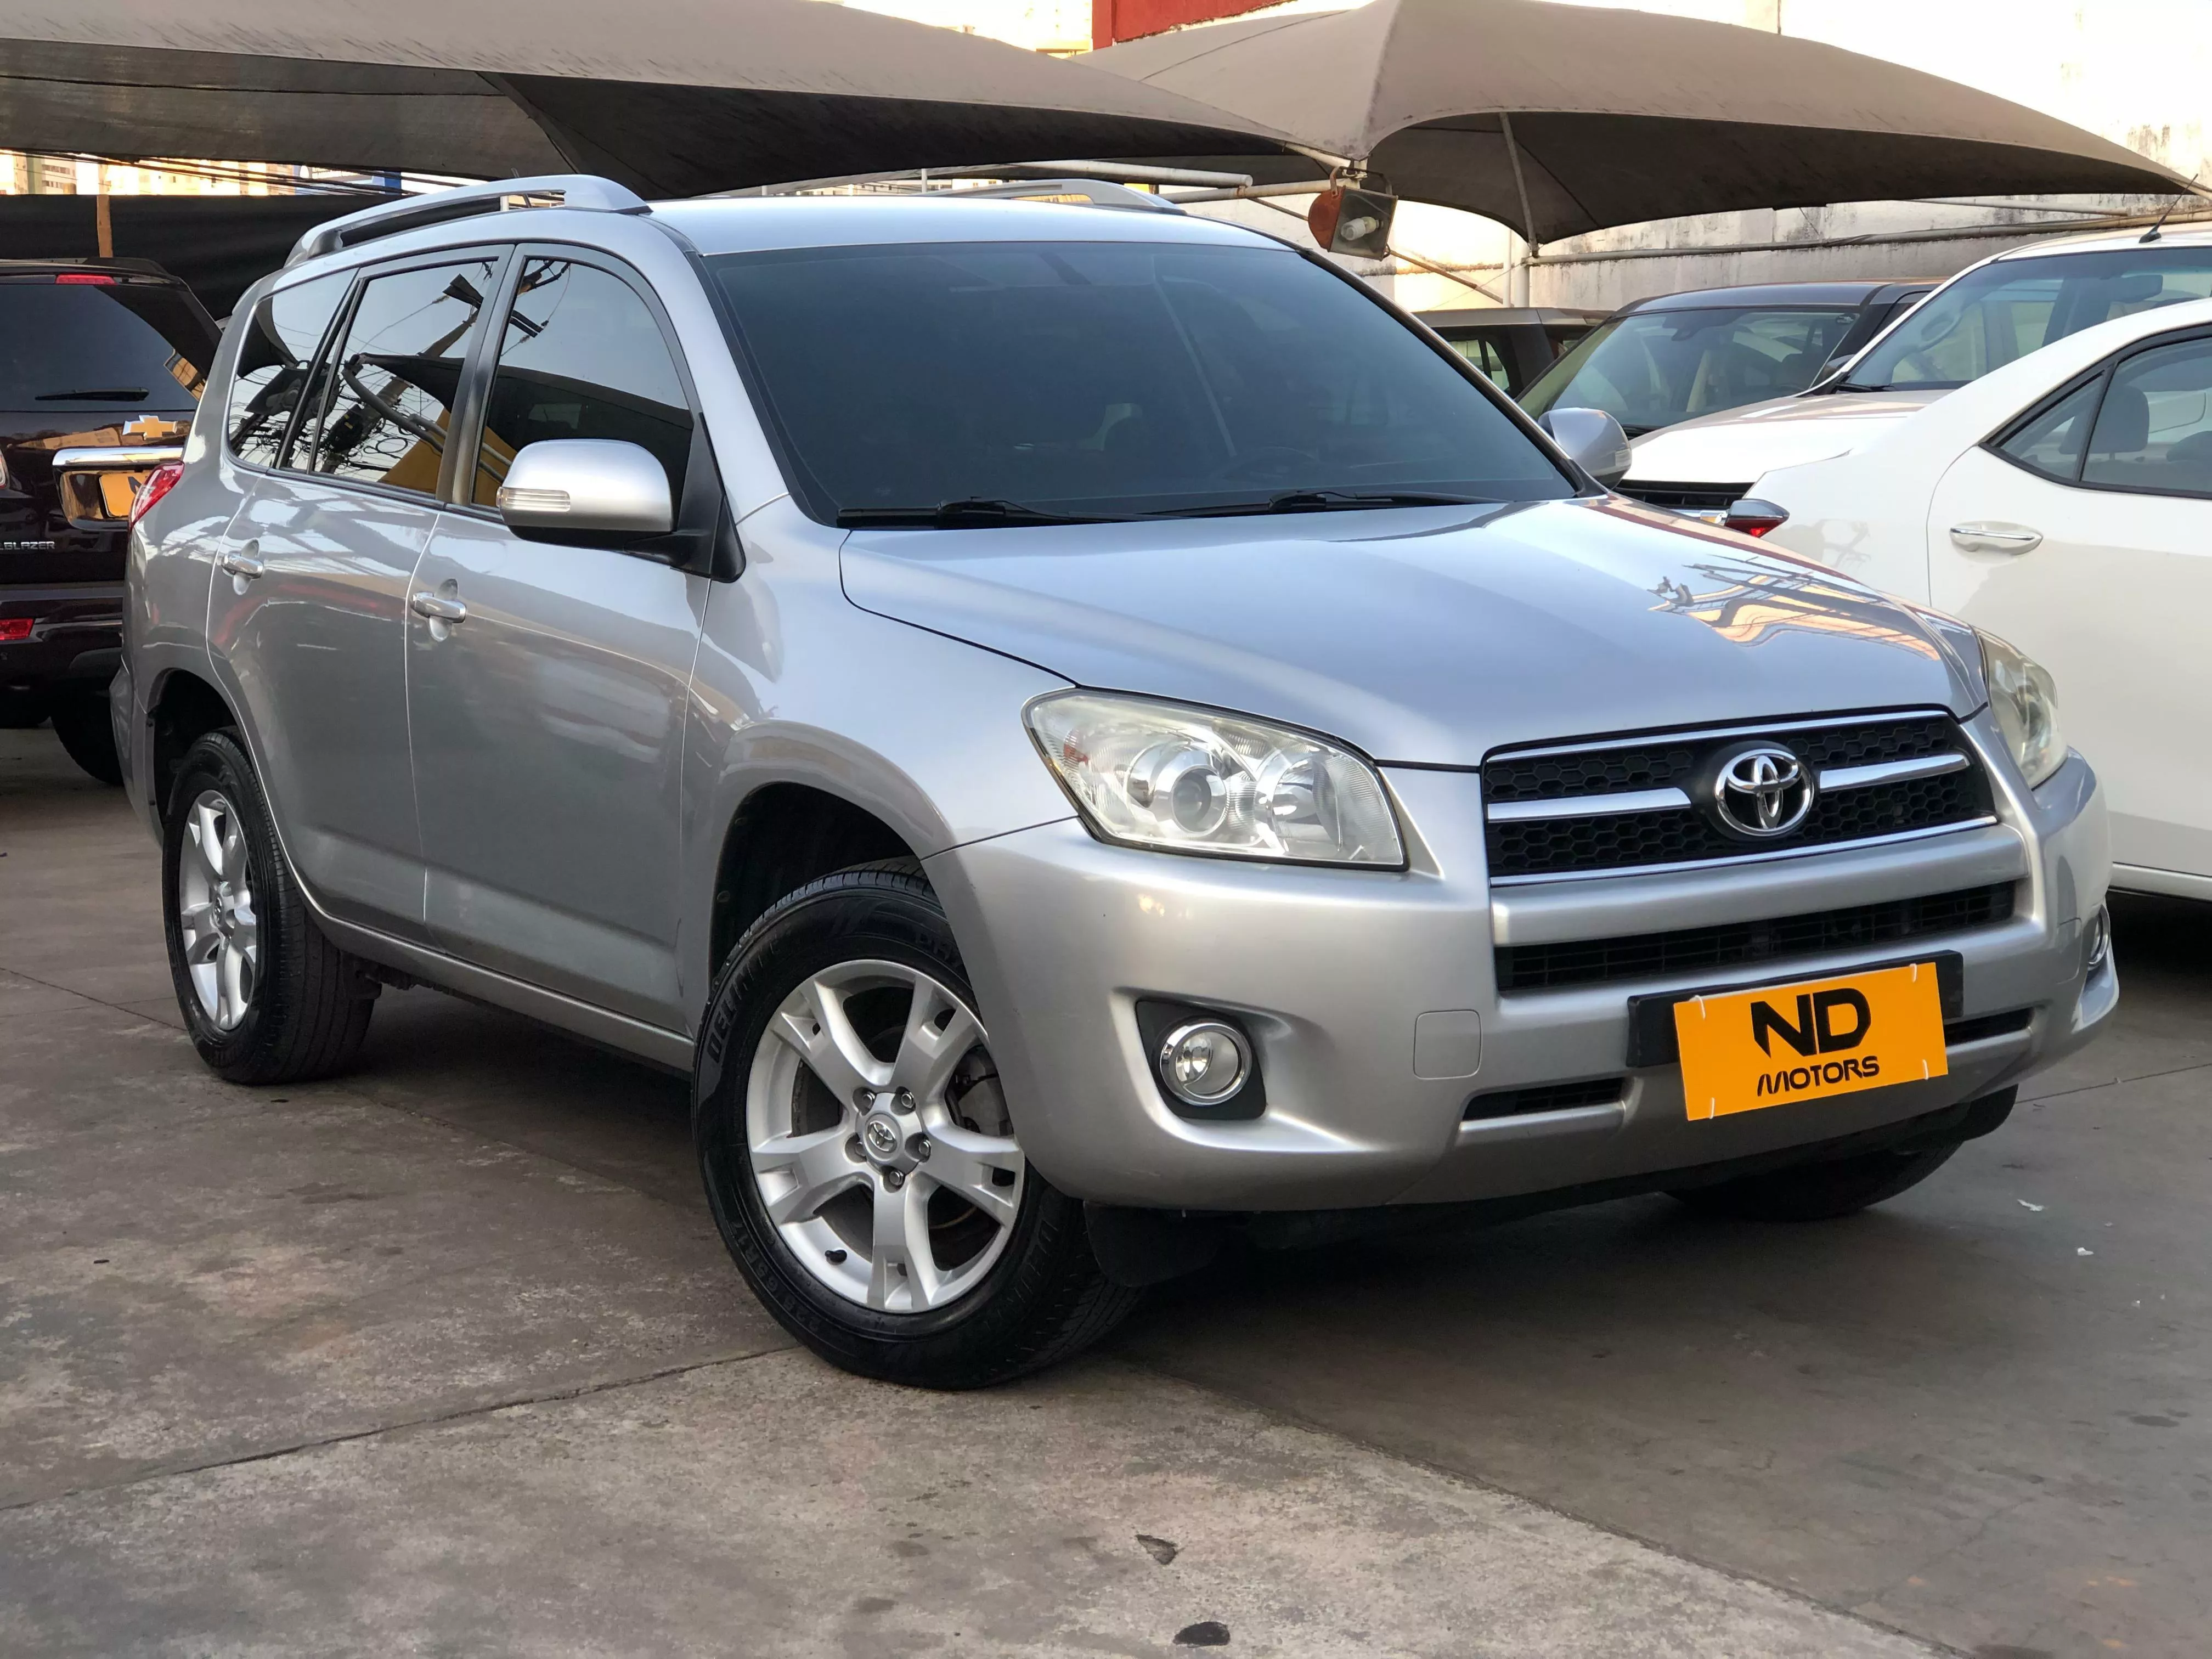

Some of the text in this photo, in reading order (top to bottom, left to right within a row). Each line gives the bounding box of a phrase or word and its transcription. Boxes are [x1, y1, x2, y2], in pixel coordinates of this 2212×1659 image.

[0, 541, 55, 550] BLAZER
[1751, 988, 1871, 1058] ND
[1757, 1056, 1880, 1096] MOTORS
